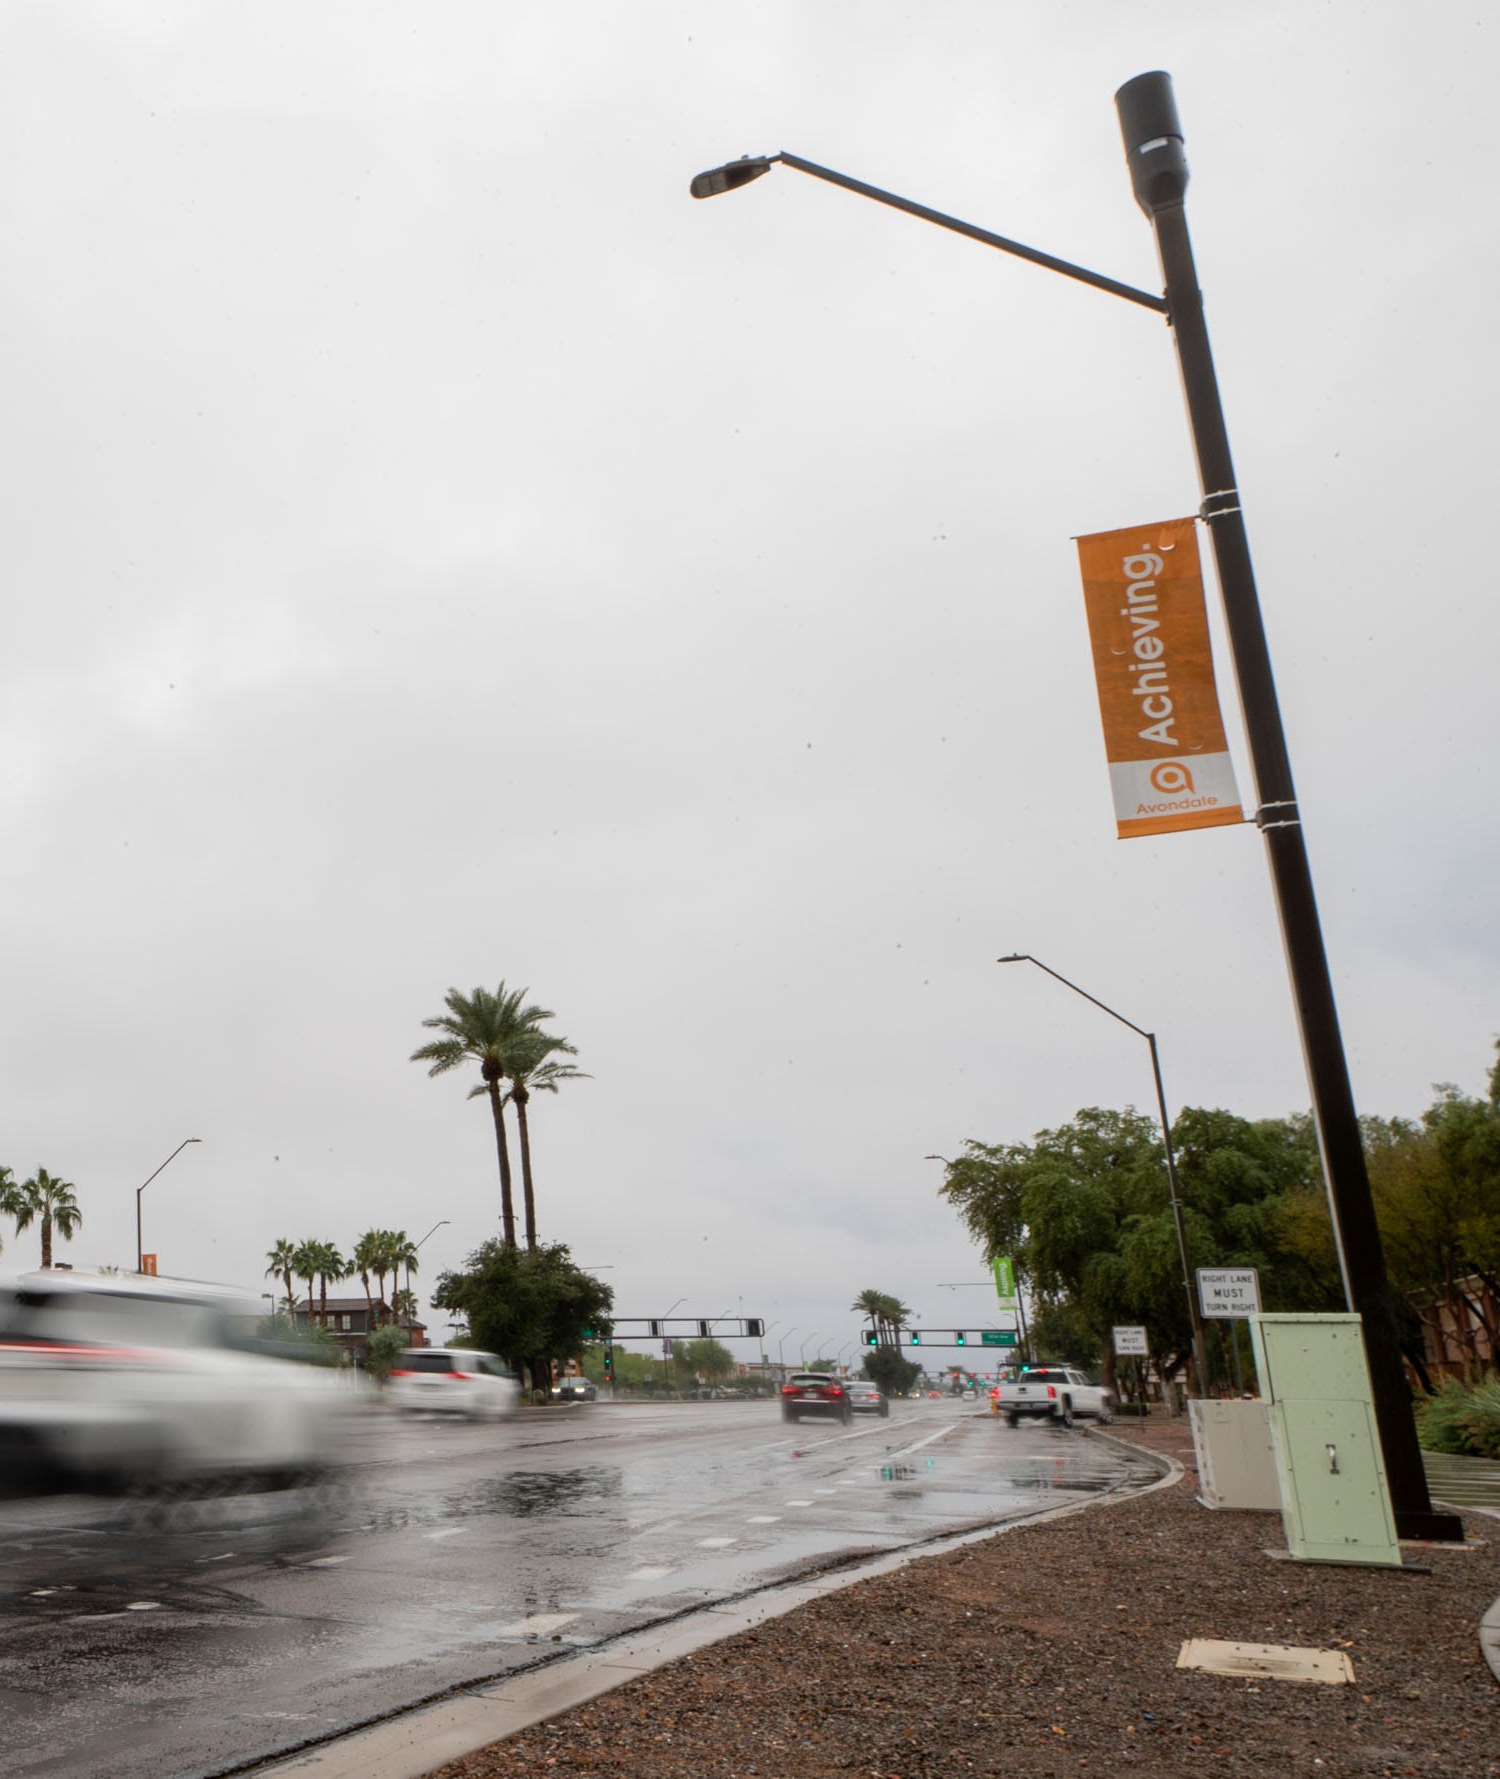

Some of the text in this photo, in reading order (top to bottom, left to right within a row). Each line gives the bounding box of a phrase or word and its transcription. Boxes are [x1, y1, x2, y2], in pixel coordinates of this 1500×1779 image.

[1120, 543, 1179, 746] Achieving.
[1136, 796, 1218, 815] Avondale
[1202, 1274, 1252, 1283] RIGHT LANE
[1213, 1288, 1243, 1298] MUST
[1206, 1303, 1255, 1312] TURN RIGHT
